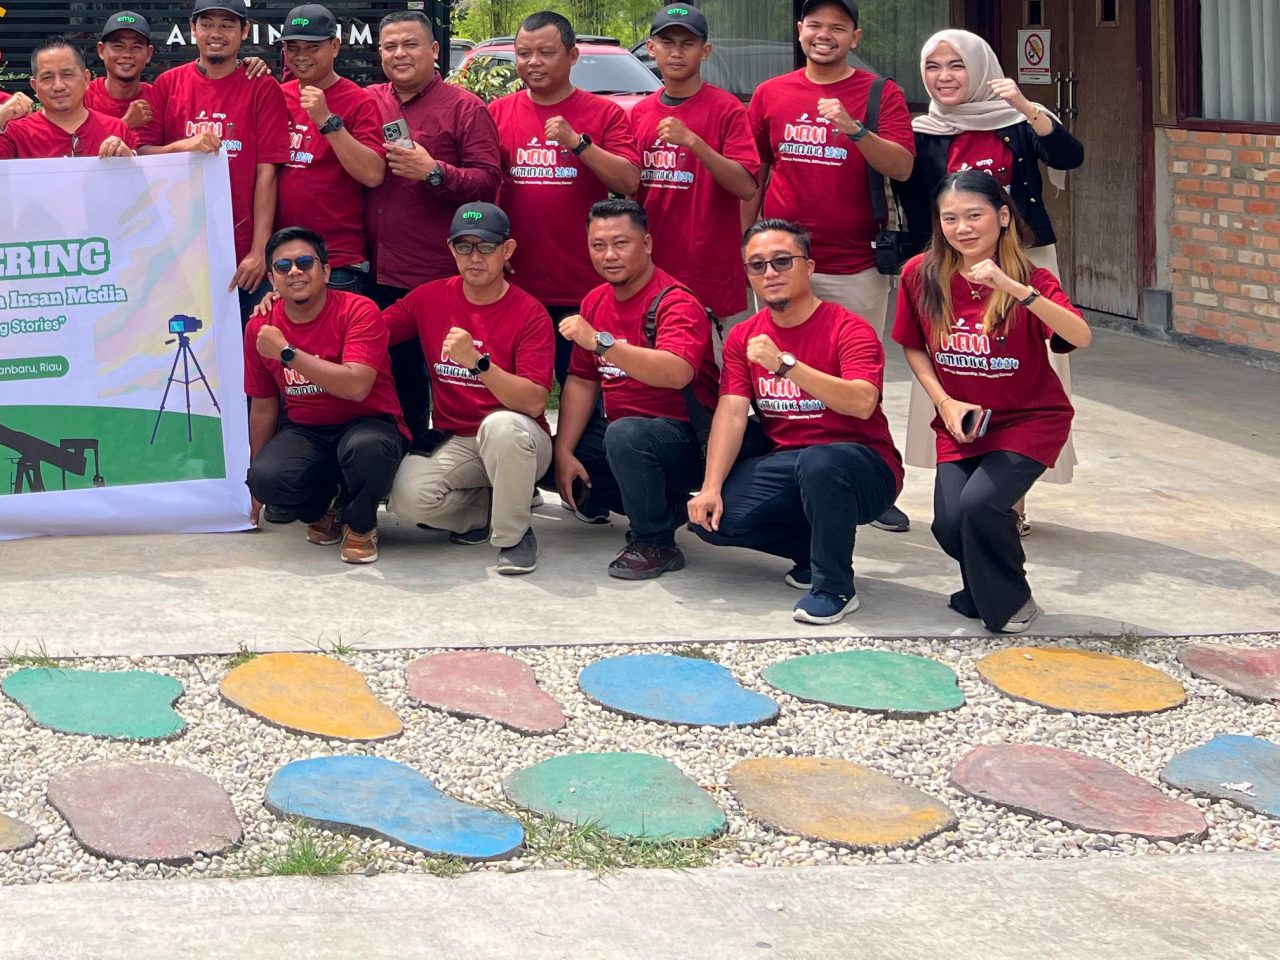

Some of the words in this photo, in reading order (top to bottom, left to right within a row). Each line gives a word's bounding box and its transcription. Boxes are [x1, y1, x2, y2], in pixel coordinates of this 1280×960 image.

[668, 7, 689, 17] emp
[117, 15, 136, 23] emp
[291, 17, 310, 27] emp
[976, 158, 993, 166] emp
[462, 210, 483, 220] emp
[10, 291, 62, 308] Insan
[66, 285, 127, 304] Media
[11, 316, 66, 333] Stories”
[40, 362, 62, 372] Riau
